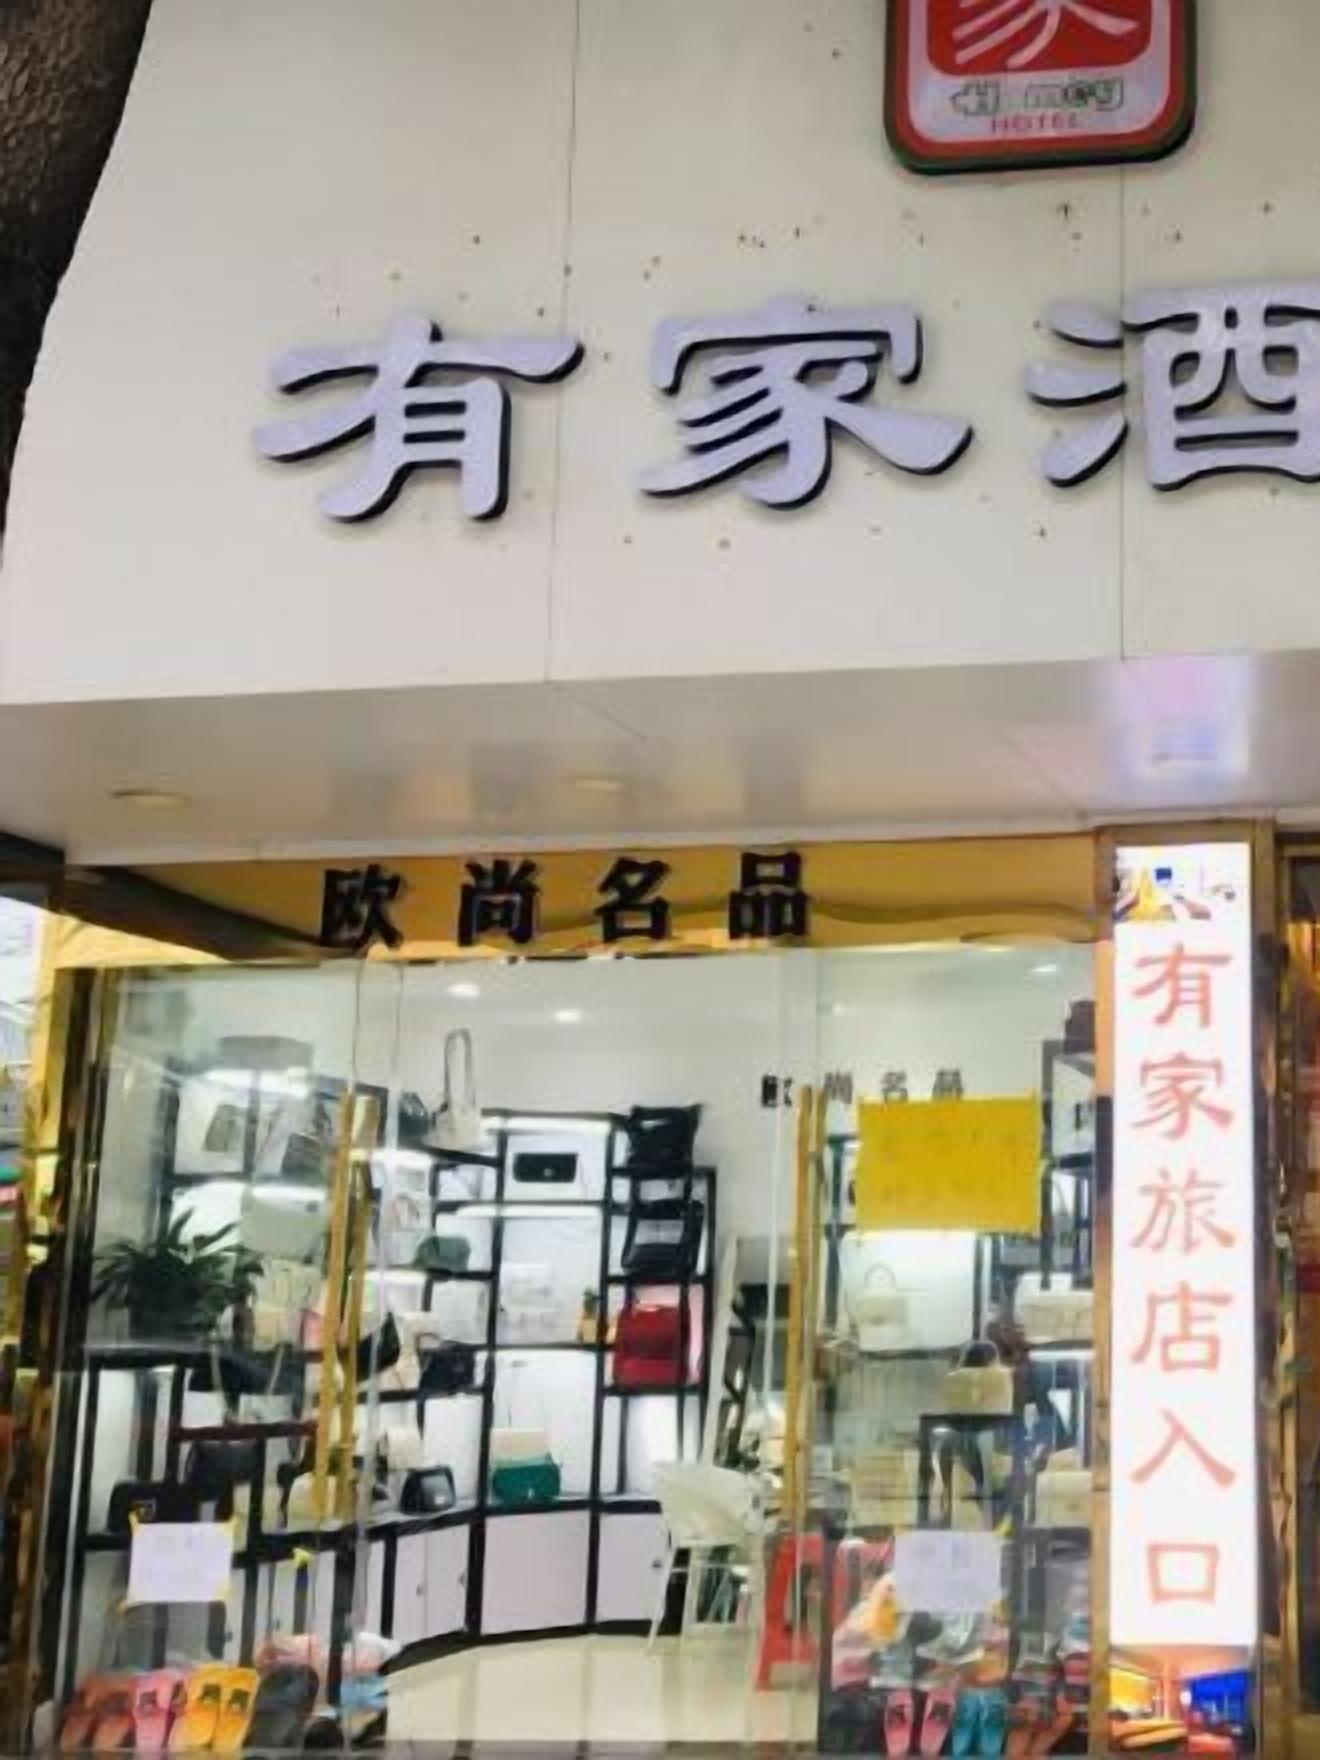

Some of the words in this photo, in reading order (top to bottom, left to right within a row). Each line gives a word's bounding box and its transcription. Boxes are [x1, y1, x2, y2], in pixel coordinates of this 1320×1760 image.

[991, 111, 1080, 133] HOTEL
[319, 851, 811, 951] 欧尚名品
[1129, 942, 1237, 1604] 有家旅店入口
